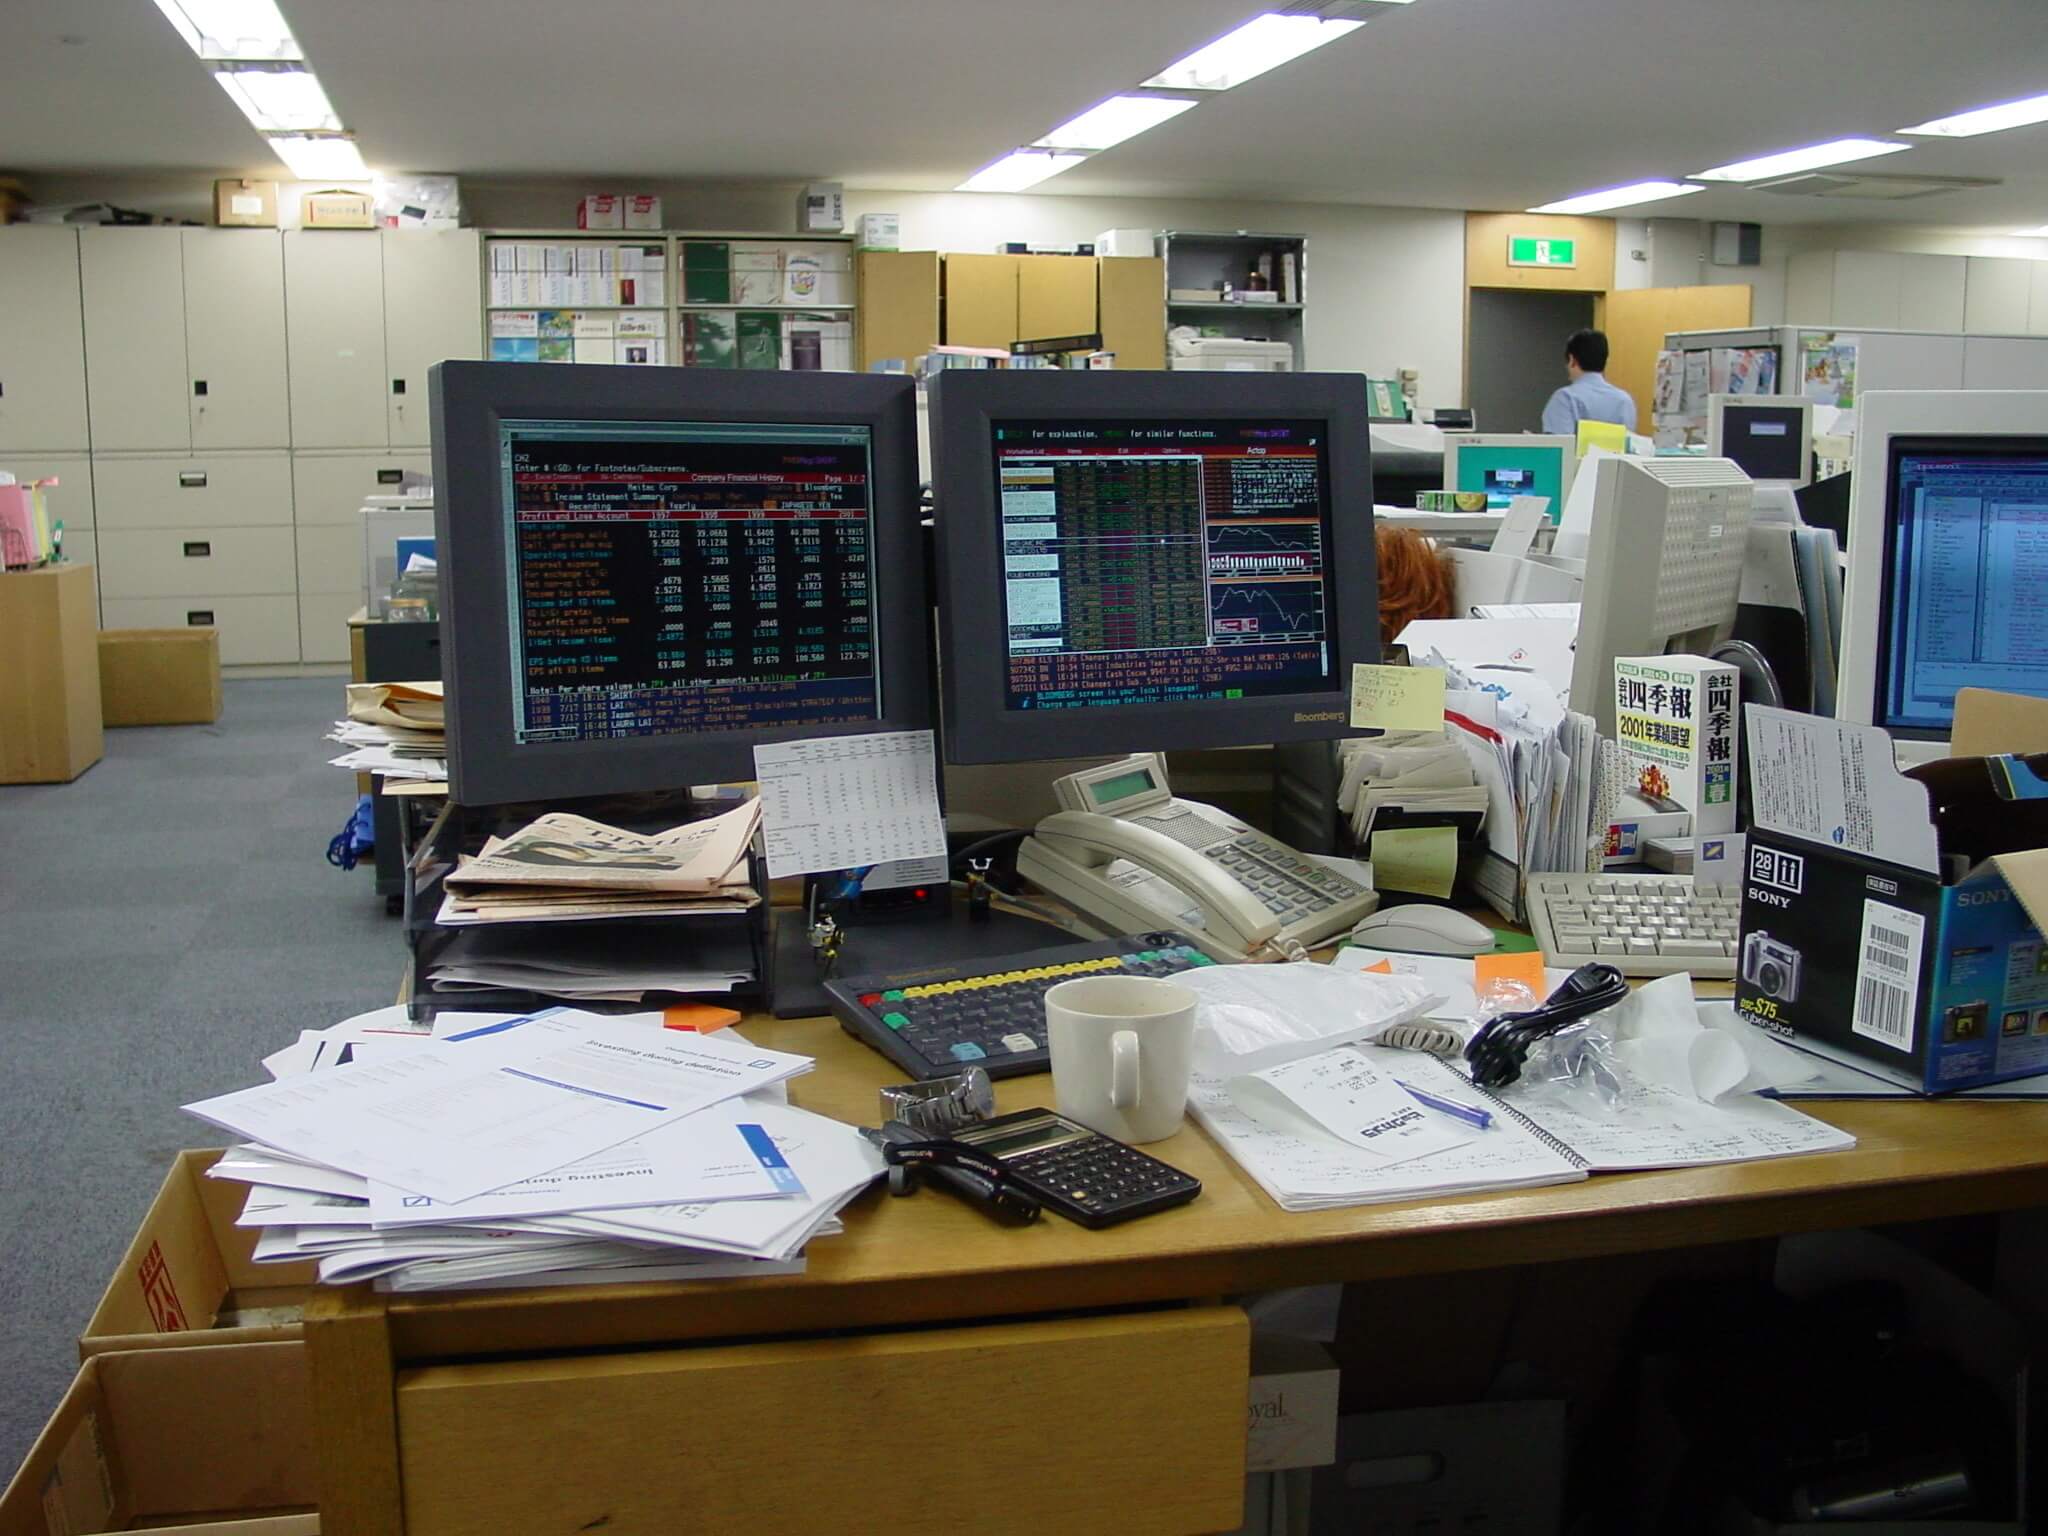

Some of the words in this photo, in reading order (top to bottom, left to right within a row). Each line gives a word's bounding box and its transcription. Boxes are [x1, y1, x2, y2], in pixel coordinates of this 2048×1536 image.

[1032, 429, 1045, 439] for
[1049, 430, 1098, 441] explanation.
[1130, 429, 1143, 439] for
[1146, 429, 1174, 439] similar
[1178, 429, 1217, 439] functions.
[515, 463, 540, 473] Enter
[577, 463, 592, 473] for
[691, 473, 725, 484] Company
[727, 473, 757, 483] Financial
[760, 473, 784, 485] History
[824, 474, 842, 484] Page
[658, 483, 678, 494] Corp
[554, 492, 583, 501] Income
[587, 492, 629, 503] Statement
[568, 502, 612, 513] Ascending
[669, 501, 697, 513] Yearly
[547, 656, 577, 666] before
[1707, 674, 1732, 688] 会社
[530, 686, 554, 696] Note:
[1080, 689, 1105, 698] screen
[1120, 687, 1137, 697] your
[1140, 685, 1160, 695] local
[1037, 700, 1063, 710] Change
[1067, 699, 1085, 709] your
[1089, 697, 1120, 707] language
[1163, 692, 1183, 703] click
[1628, 680, 1692, 721] 四季報
[1294, 711, 1345, 723] Bloomberg
[1706, 689, 1732, 761] 四季報
[1755, 851, 1773, 871] 28
[1748, 887, 1791, 909] SONY
[586, 1039, 641, 1056] Investing
[643, 1051, 682, 1066] during
[684, 1062, 742, 1077] deflation
[568, 1169, 653, 1182] Investing
